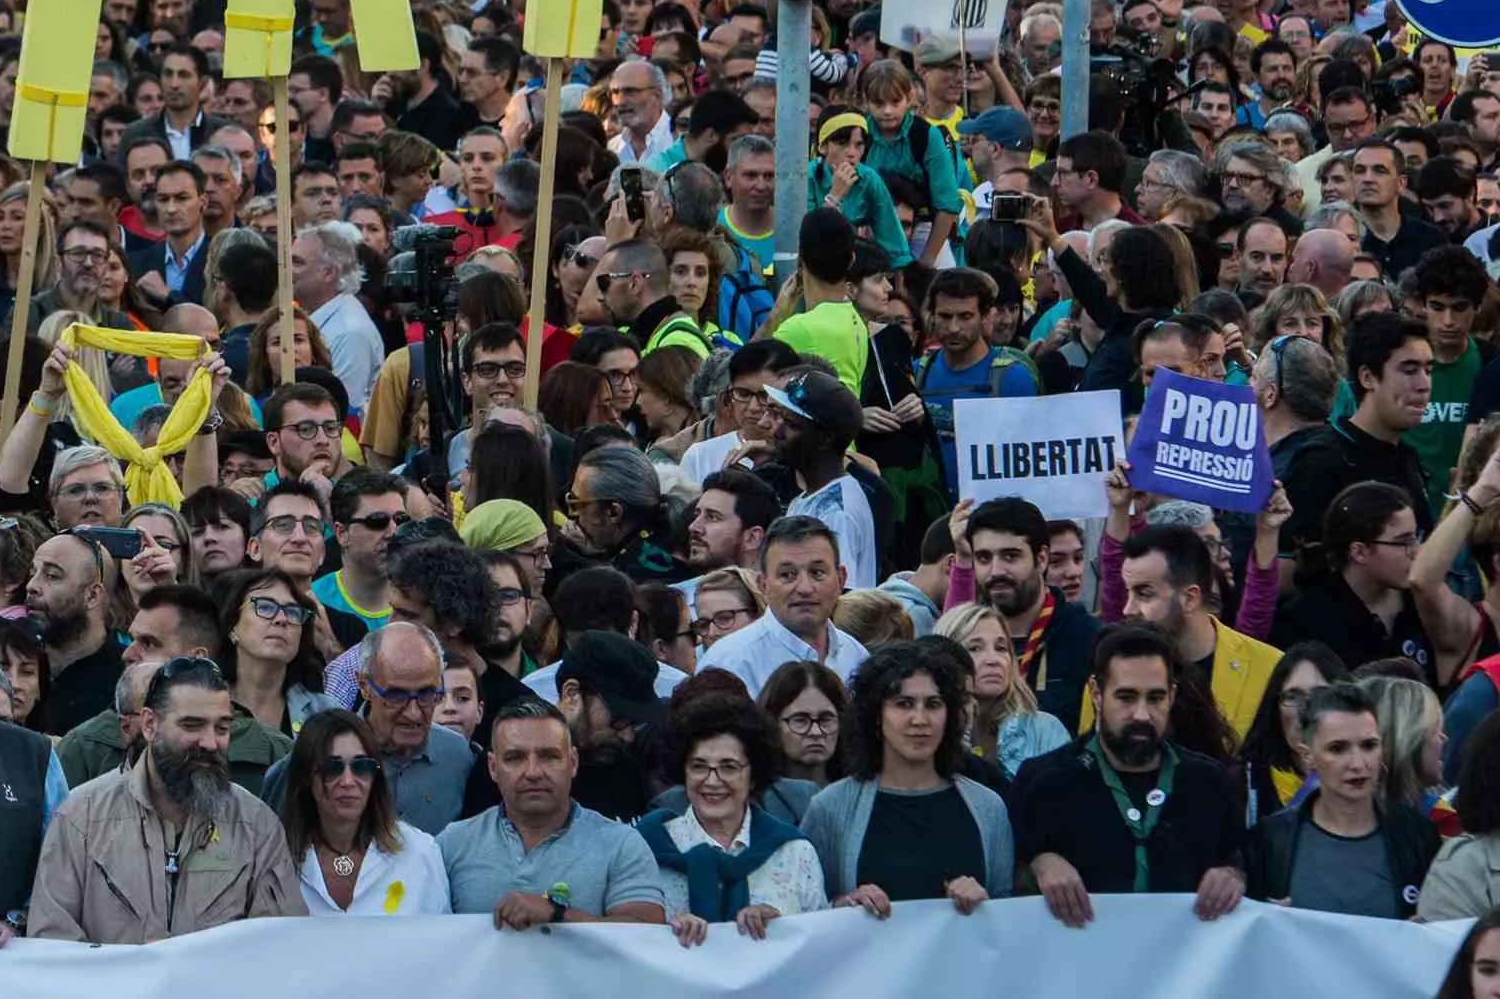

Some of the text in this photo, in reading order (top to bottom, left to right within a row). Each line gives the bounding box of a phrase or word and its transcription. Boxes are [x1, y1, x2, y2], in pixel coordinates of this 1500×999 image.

[1160, 388, 1258, 451] PROU
[970, 436, 1116, 480] LLIBERTAT
[1156, 441, 1253, 482] REPRESSIÓ
